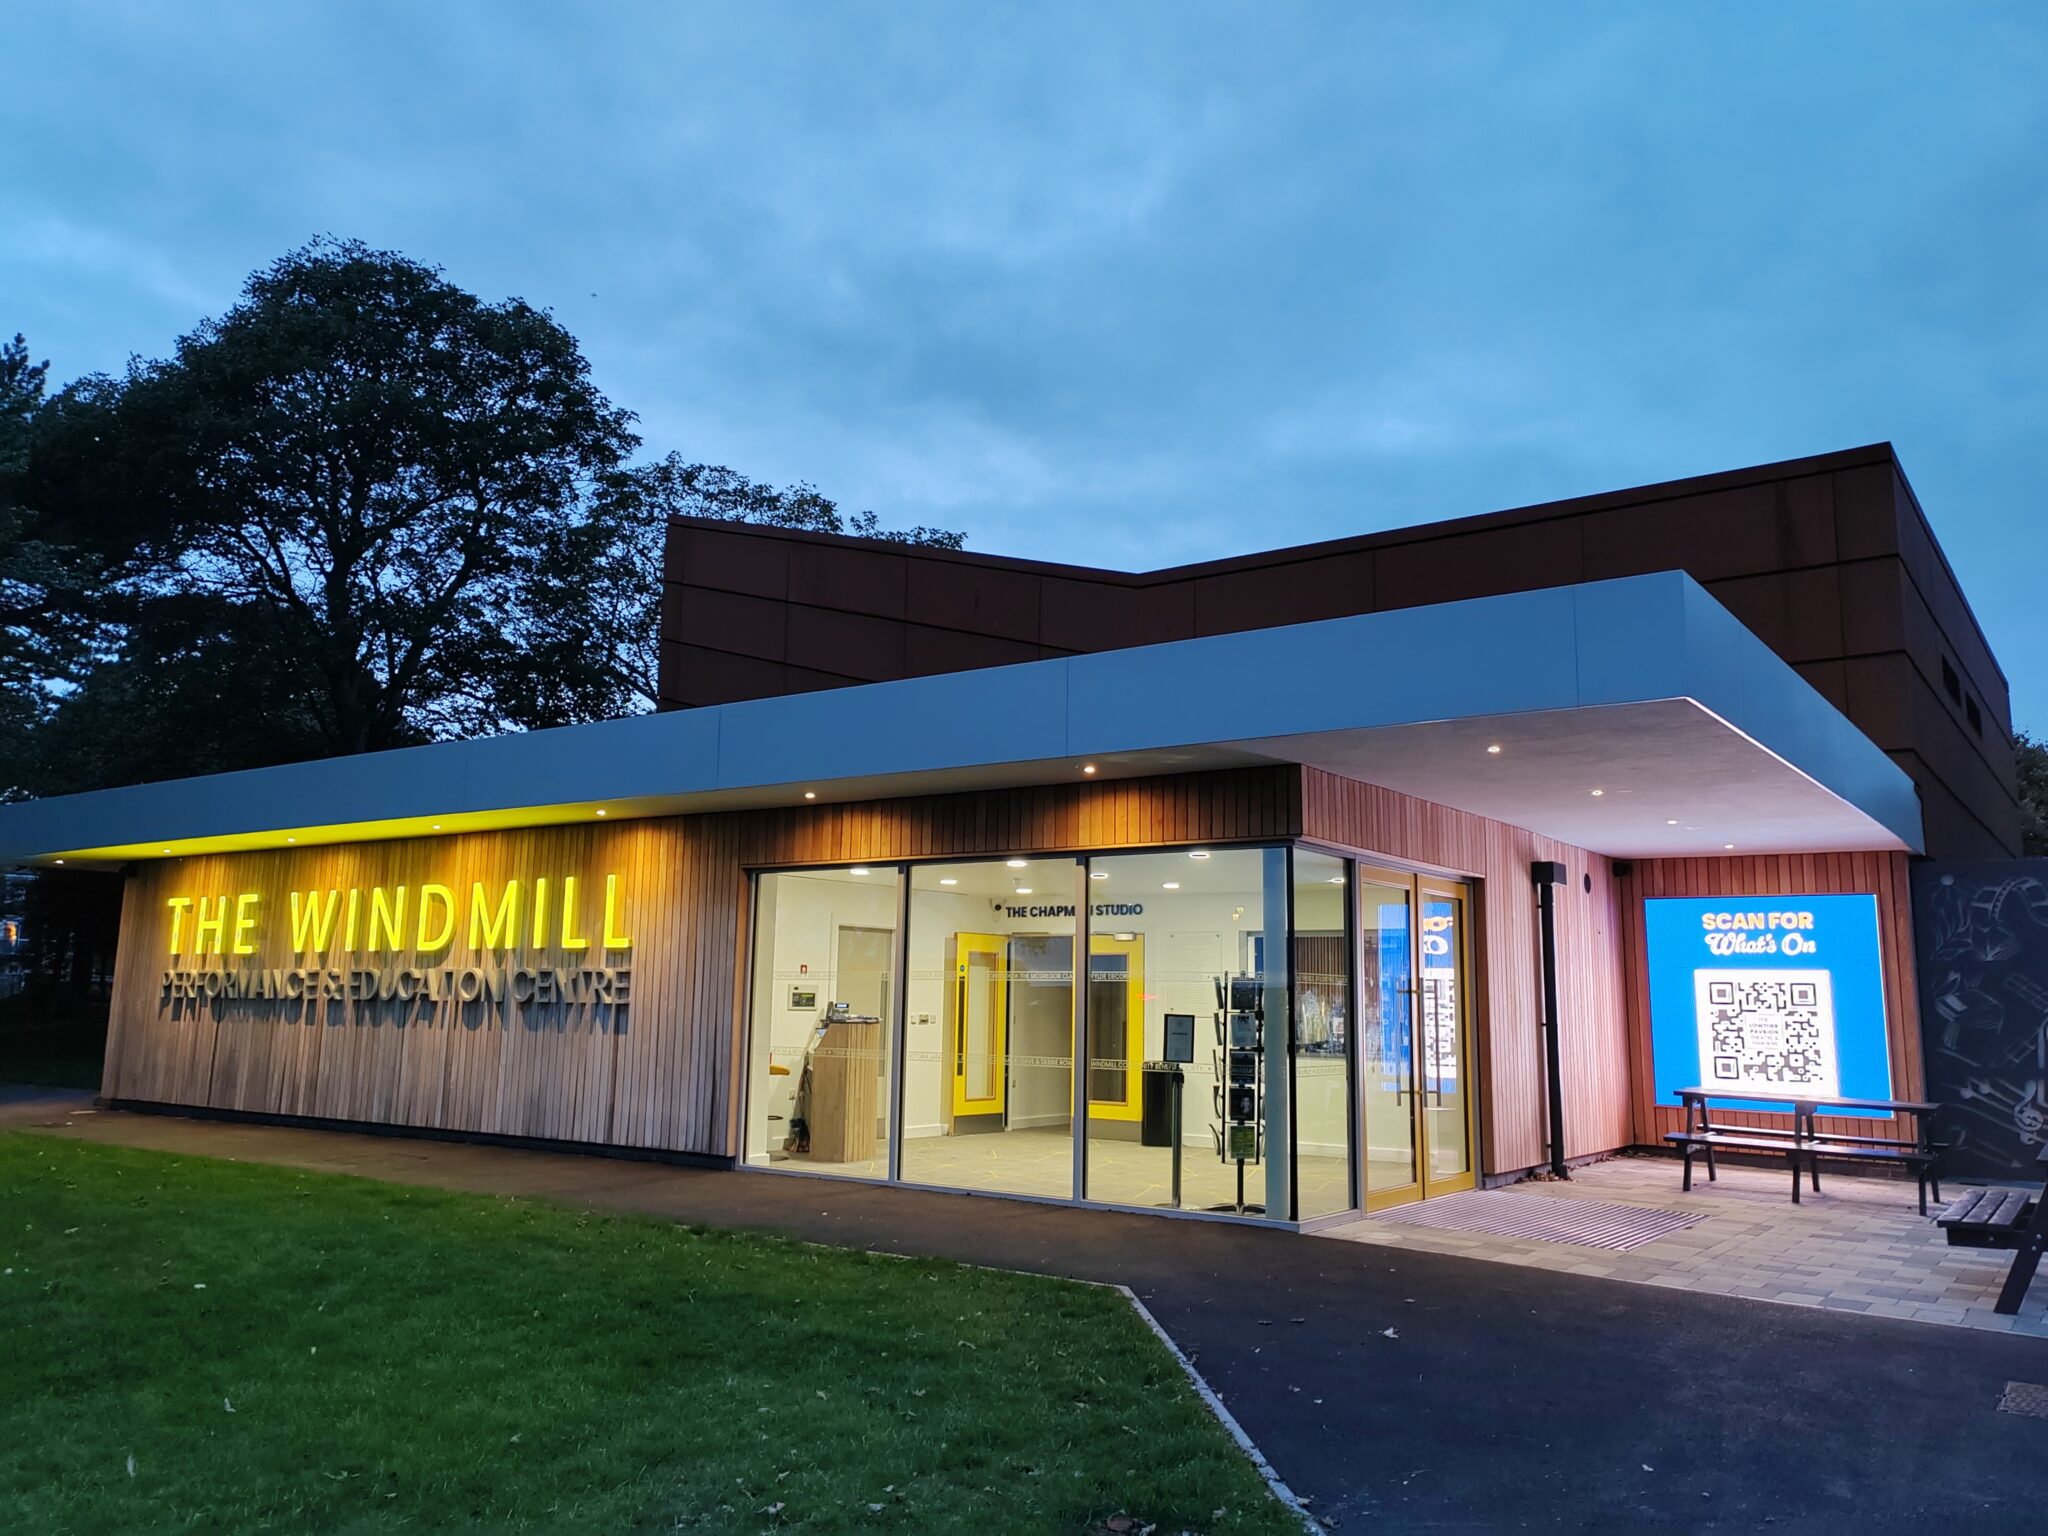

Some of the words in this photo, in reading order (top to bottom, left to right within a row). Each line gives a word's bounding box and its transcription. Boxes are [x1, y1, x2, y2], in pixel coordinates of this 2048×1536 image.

[167, 893, 261, 955] THE
[290, 874, 634, 952] WINDMILL
[1006, 906, 1027, 918] THE
[1030, 905, 1094, 917] CHAPM
[1095, 903, 1143, 916] STUDIO
[1702, 912, 1765, 930] SCAN
[1768, 911, 1814, 930] FOR
[1704, 932, 1777, 956] What's
[1781, 932, 1817, 956] On
[161, 968, 321, 1000] PERFORMANCE
[322, 968, 344, 1001] &
[350, 967, 507, 1003] EDUCATION
[511, 967, 631, 1004] CENTRE
